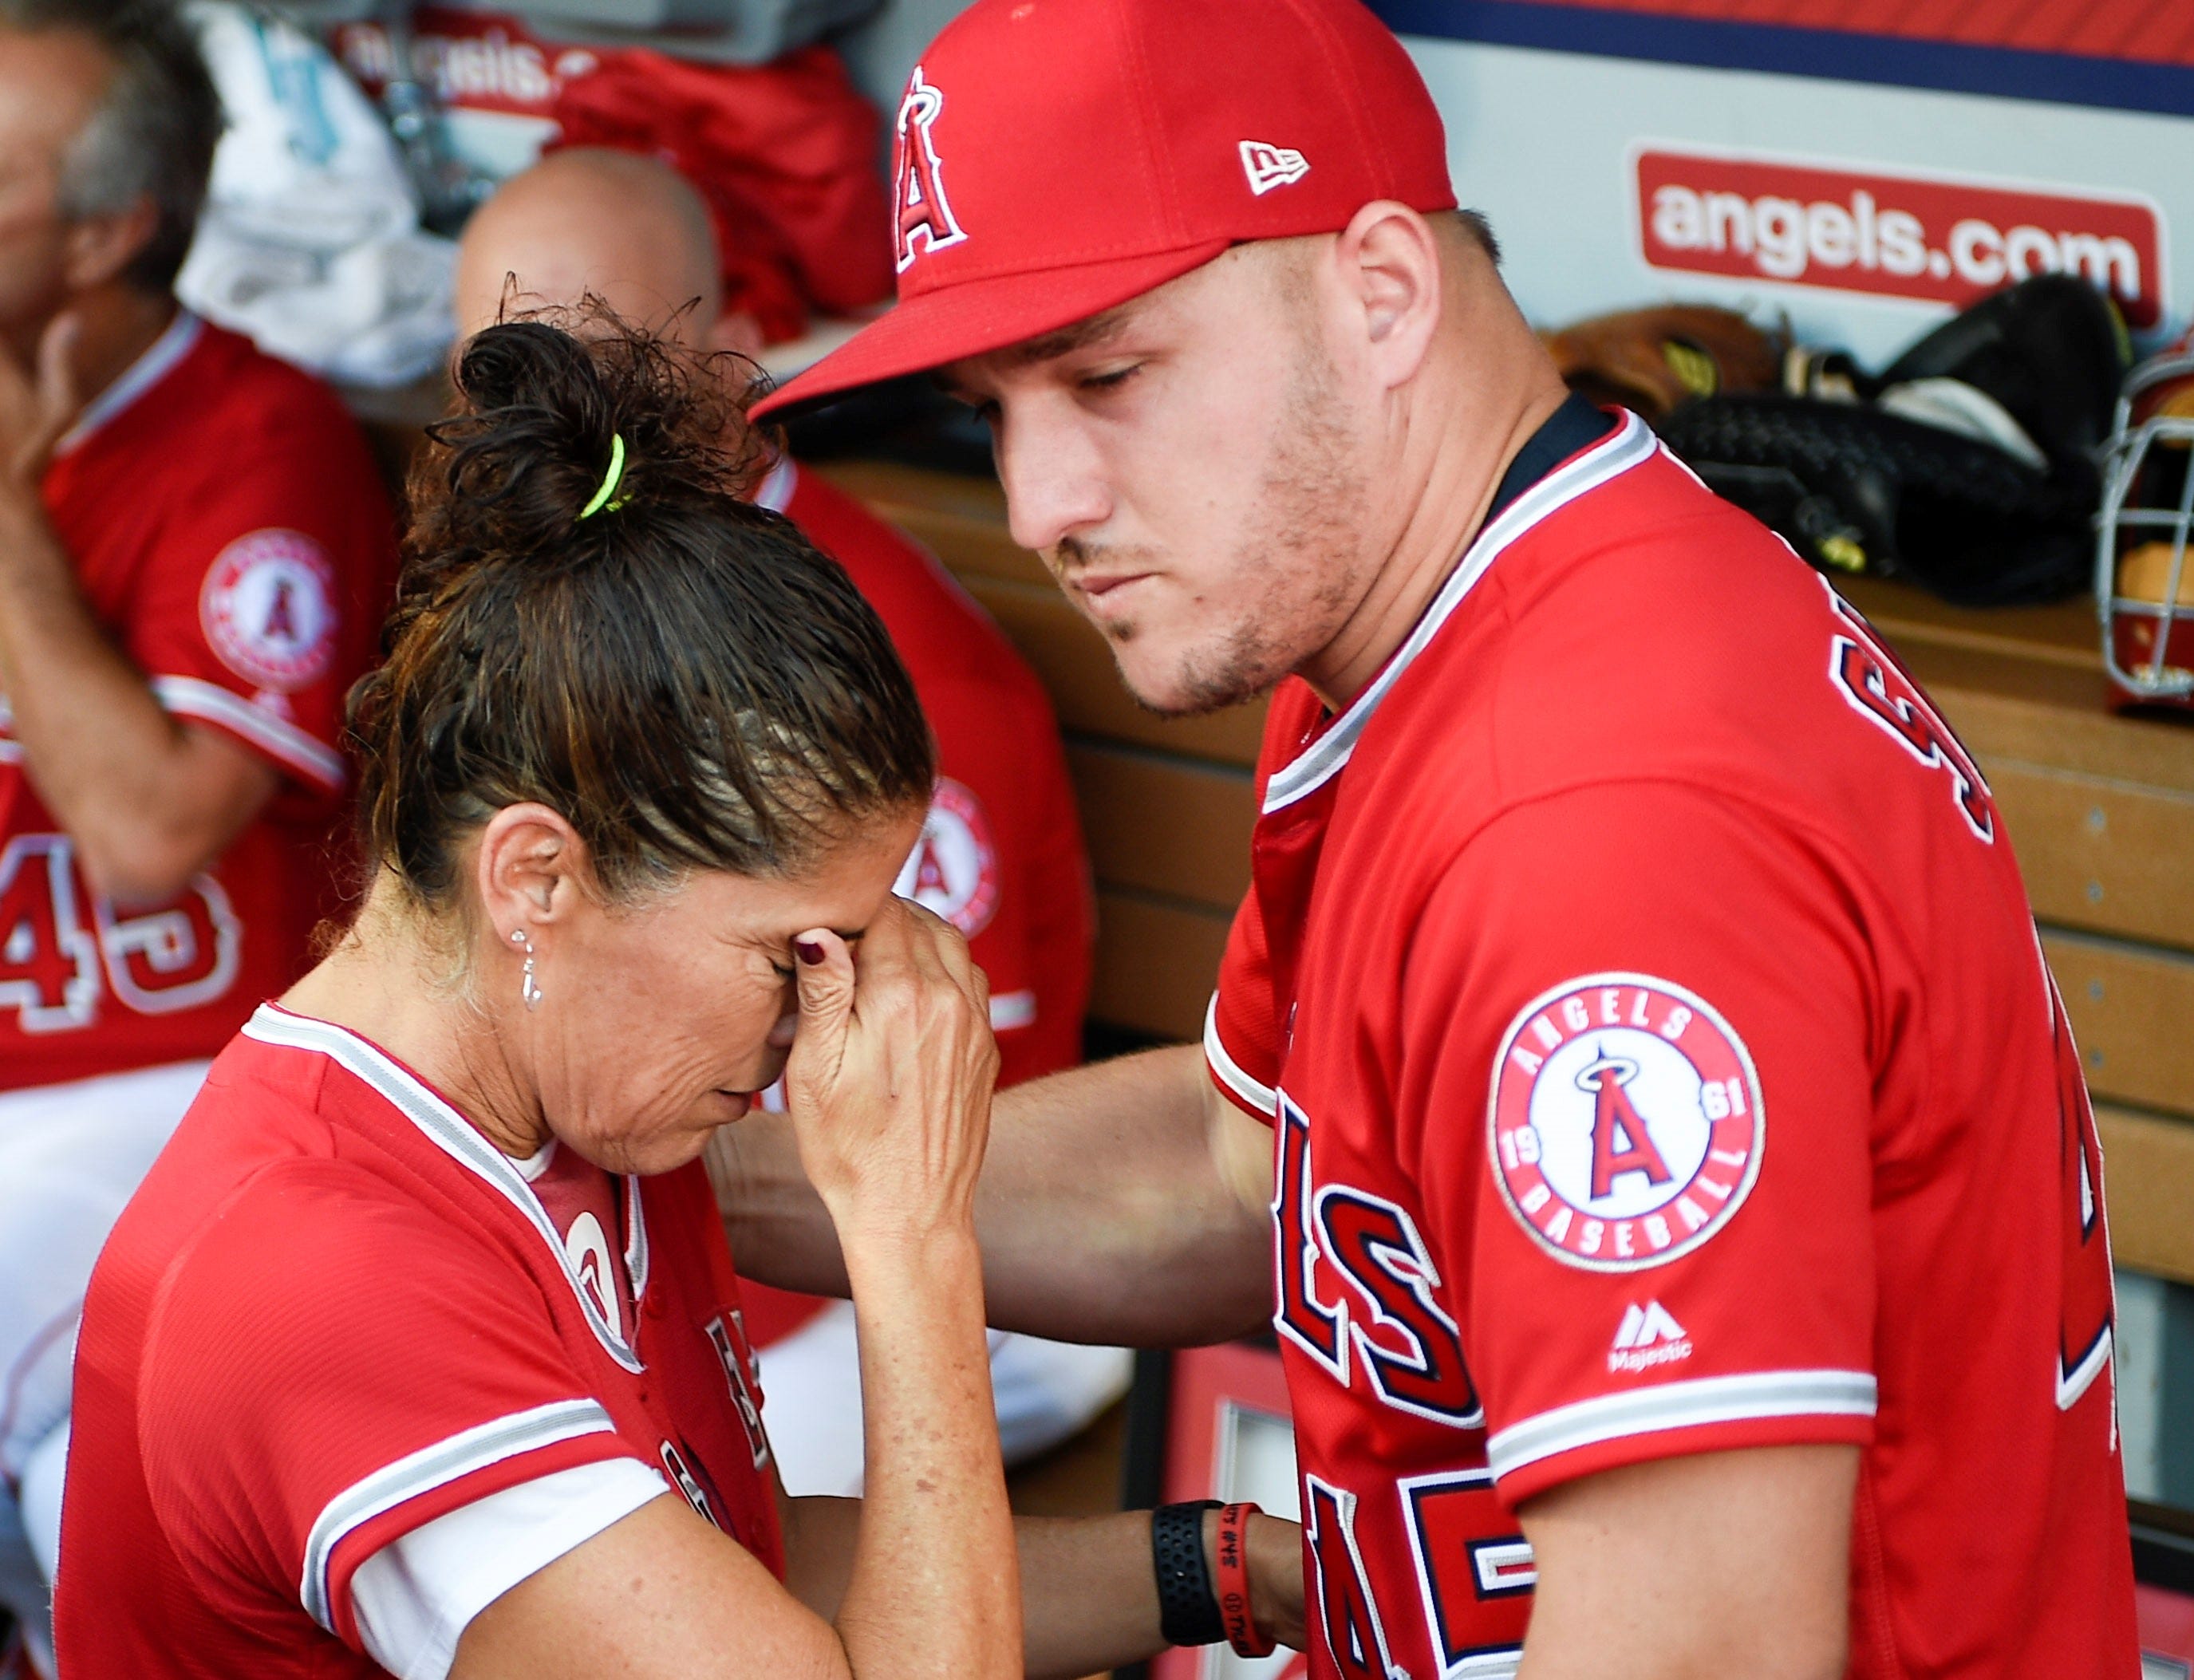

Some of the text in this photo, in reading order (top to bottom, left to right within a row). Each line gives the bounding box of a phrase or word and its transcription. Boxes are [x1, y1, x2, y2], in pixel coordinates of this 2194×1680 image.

[894, 65, 969, 274] A
[1651, 184, 2141, 303] angels.com
[1511, 988, 1693, 1075] ANGELS
[1500, 1125, 1540, 1169] 19
[1589, 1055, 1674, 1202] A
[1701, 1077, 1747, 1121] 61
[1519, 1148, 1747, 1257] BASEBALL
[1270, 1087, 1486, 1430] LS
[1606, 1339, 1694, 1374] Majestic
